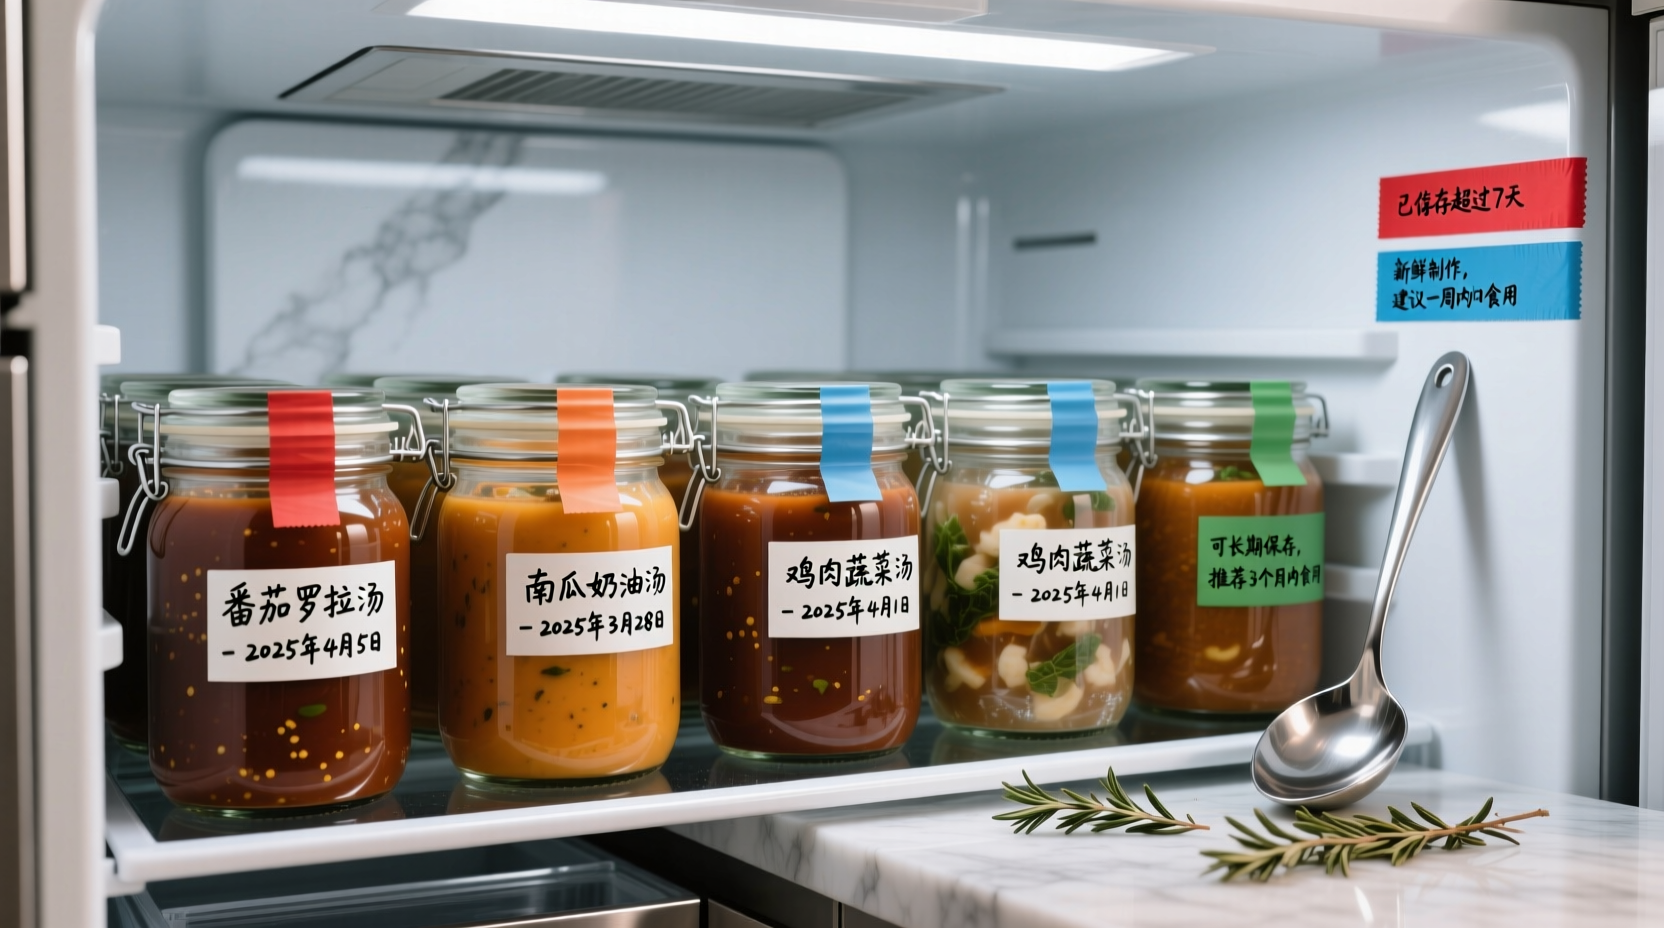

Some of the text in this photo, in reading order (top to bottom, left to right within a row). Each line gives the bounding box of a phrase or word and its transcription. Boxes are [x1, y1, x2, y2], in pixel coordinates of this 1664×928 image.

[785, 549, 913, 590] 鸡肉蔬菜汤
[1016, 538, 1132, 575] 鸡肉蔬菜汤
[221, 581, 384, 628] 番茄罗拉汤
[525, 566, 666, 606] 南瓜奶油汤
